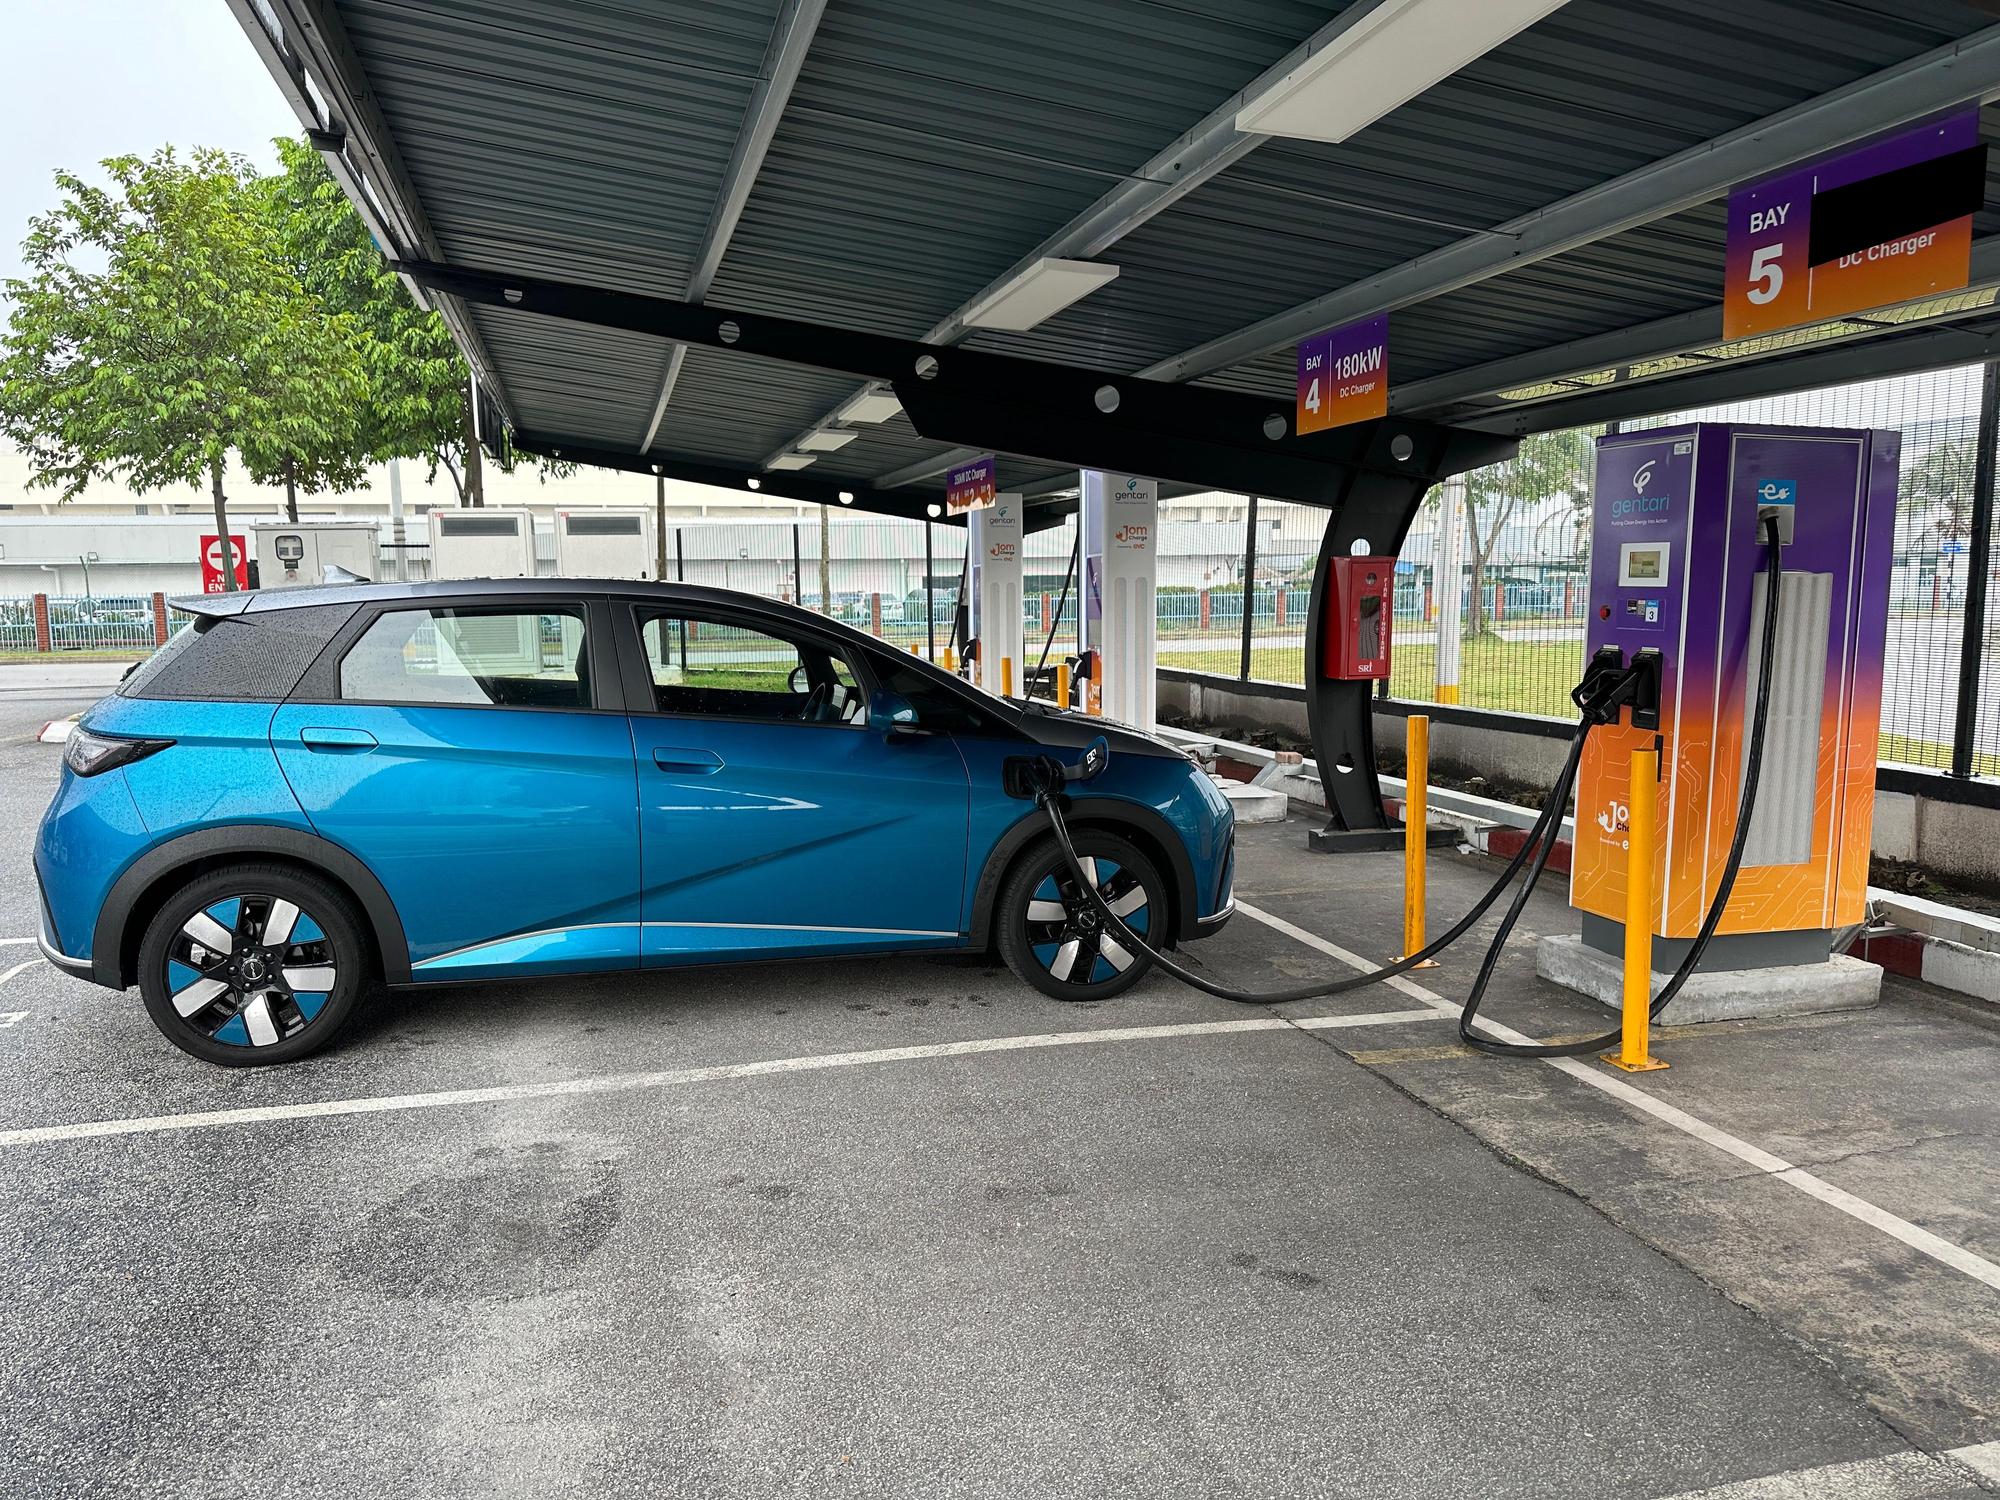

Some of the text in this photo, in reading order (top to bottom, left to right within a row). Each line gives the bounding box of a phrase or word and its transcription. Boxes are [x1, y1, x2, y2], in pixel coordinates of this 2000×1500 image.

[1750, 203, 1791, 234] BAY
[1868, 232, 1936, 262] Charger
[1747, 243, 1784, 305] 5
[1306, 354, 1322, 371] BAY
[1335, 345, 1382, 380] 180kW
[1305, 378, 1320, 415] 4
[1340, 382, 1376, 398] DC Charger
[1115, 491, 1148, 501] gentari
[1612, 494, 1670, 518] gentari
[209, 583, 243, 591] ENY
